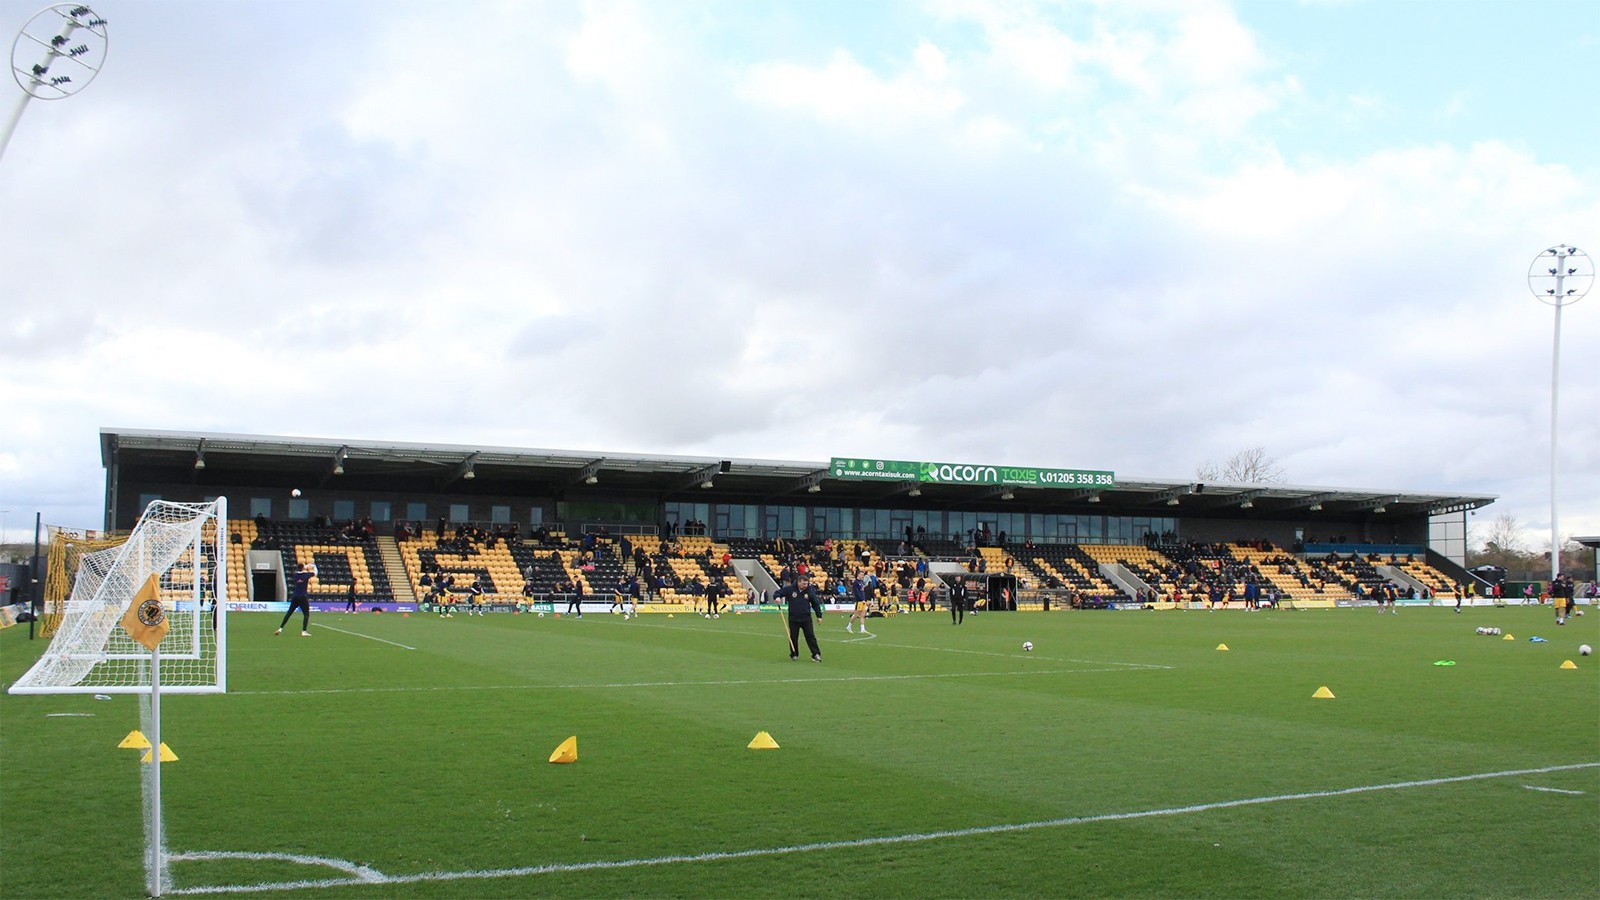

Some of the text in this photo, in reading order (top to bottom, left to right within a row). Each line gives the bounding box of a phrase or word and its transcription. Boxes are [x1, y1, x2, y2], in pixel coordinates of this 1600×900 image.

[844, 470, 915, 479] www.acorntaxisuk.com
[940, 465, 997, 482] acorn
[1046, 472, 1112, 485] 01205 358 358
